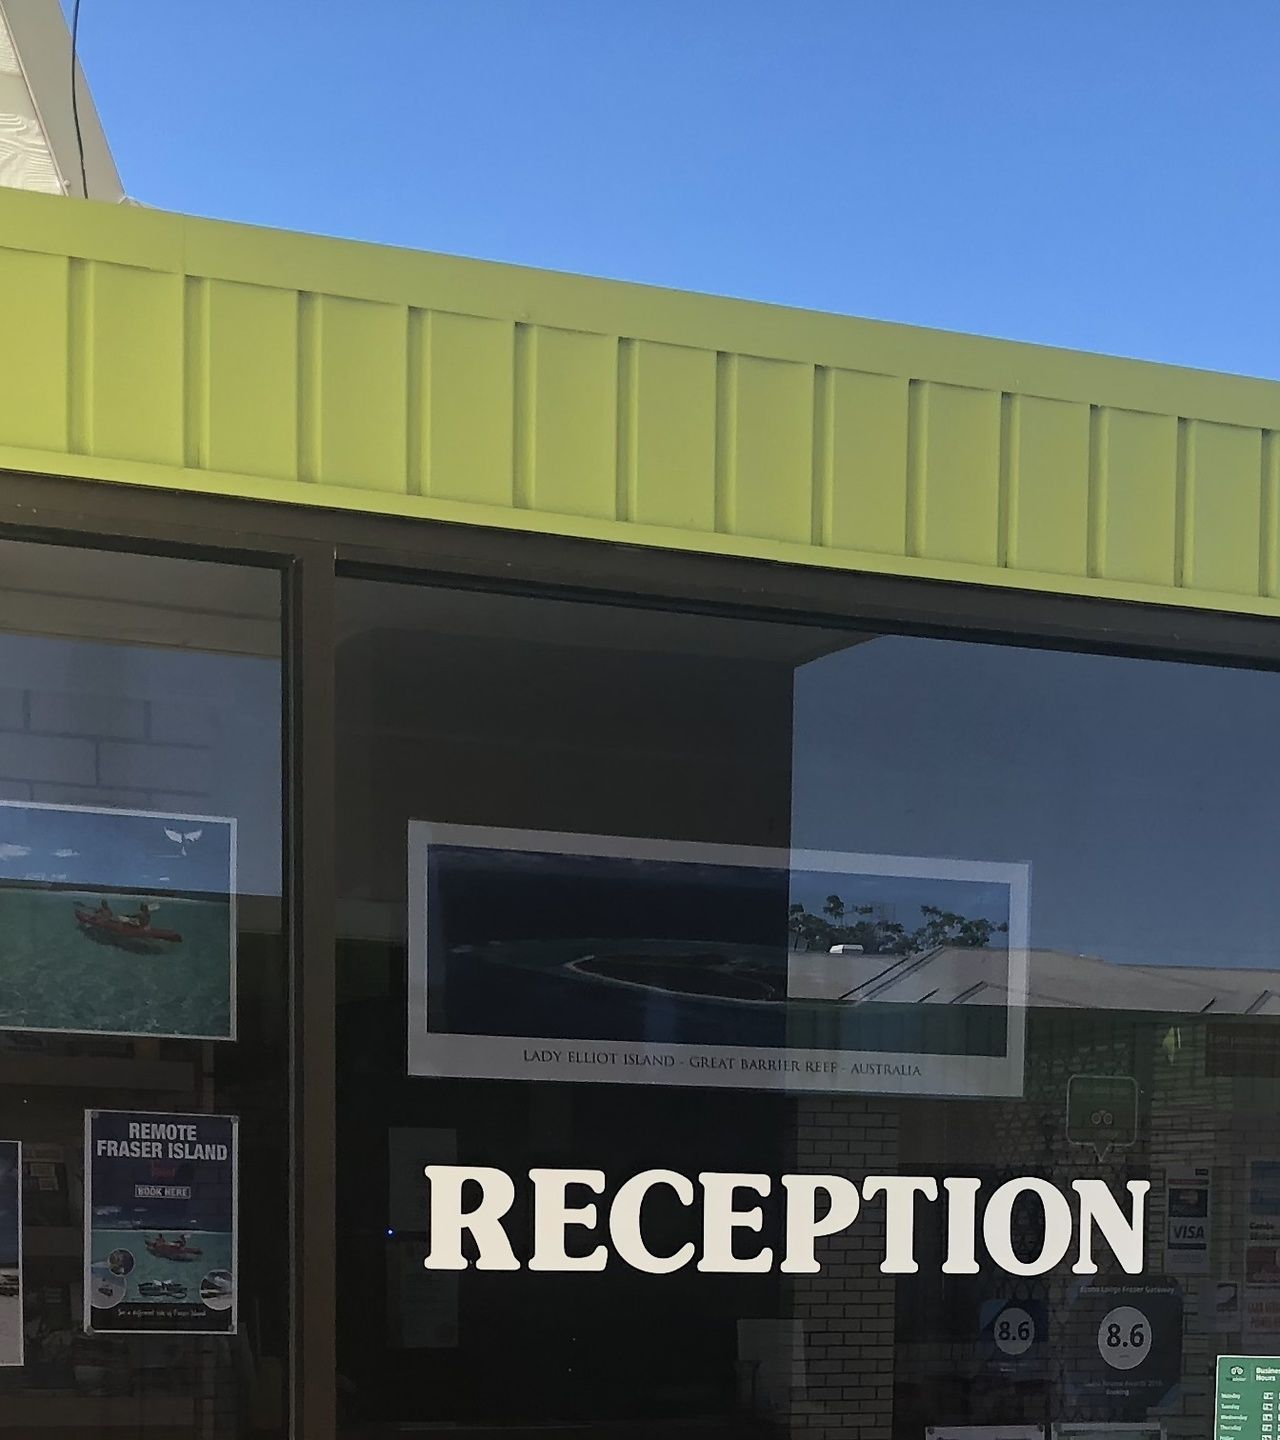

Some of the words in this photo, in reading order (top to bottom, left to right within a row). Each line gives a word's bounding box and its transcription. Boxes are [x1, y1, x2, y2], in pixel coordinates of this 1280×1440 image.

[523, 1049, 562, 1062] LADY
[568, 1051, 618, 1065] ELLIOT
[623, 1053, 675, 1067] ISLAND
[689, 1055, 736, 1070] GREAT
[741, 1058, 801, 1072] BARRIER
[805, 1060, 838, 1073] REEF
[851, 1063, 922, 1077] AUSTRALIA
[128, 1122, 197, 1141] REMOTE
[97, 1139, 163, 1159] FRASER
[168, 1143, 228, 1161] ISLAND
[165, 1186, 188, 1197] HERE
[423, 1164, 1151, 1276] RECEPTION
[1173, 1226, 1205, 1239] VISA
[998, 1321, 1031, 1341] 8.6
[1106, 1322, 1145, 1348] 8.6
